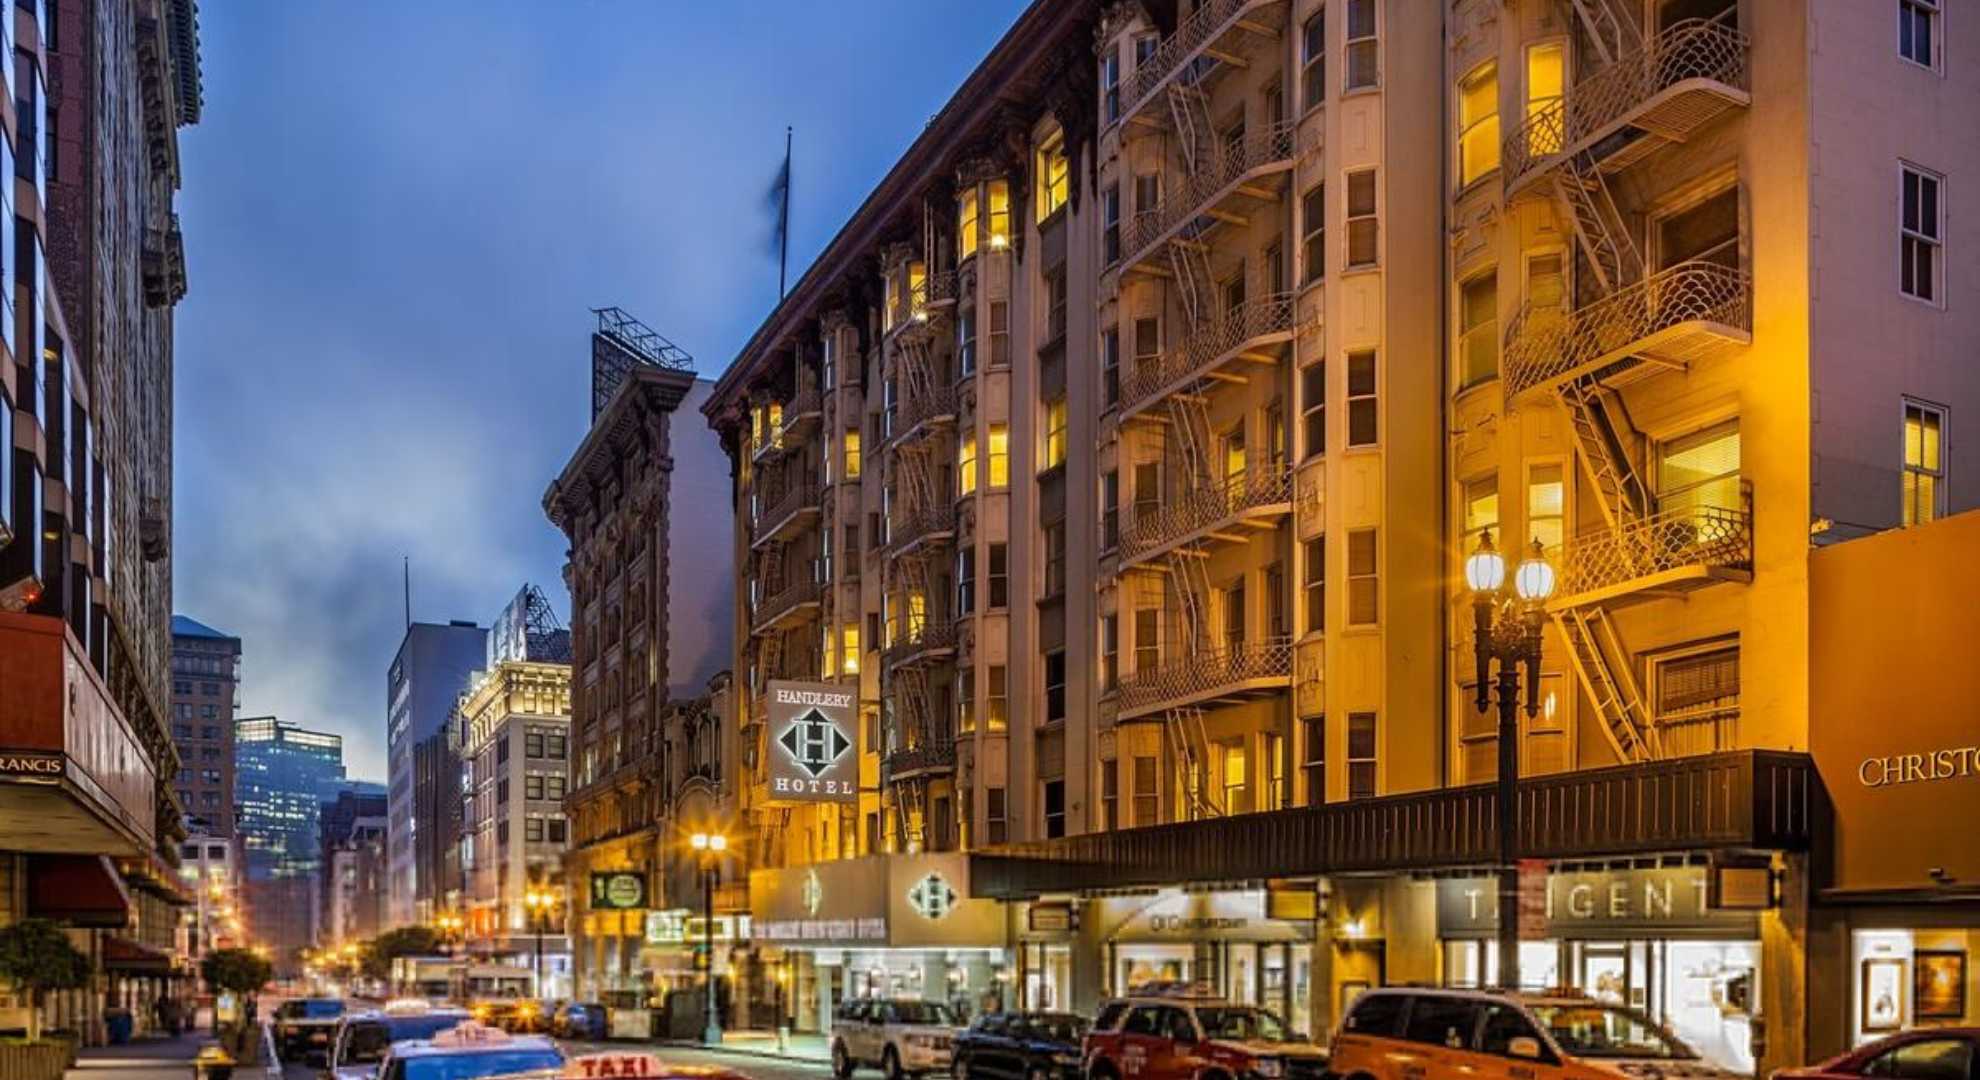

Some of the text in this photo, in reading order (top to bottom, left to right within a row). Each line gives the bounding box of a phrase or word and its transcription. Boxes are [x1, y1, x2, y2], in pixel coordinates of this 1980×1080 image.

[777, 689, 851, 708] HANDLERY
[1859, 747, 1980, 786] CHRIST
[776, 778, 853, 794] HOTEL
[581, 1056, 647, 1077] TAXI
